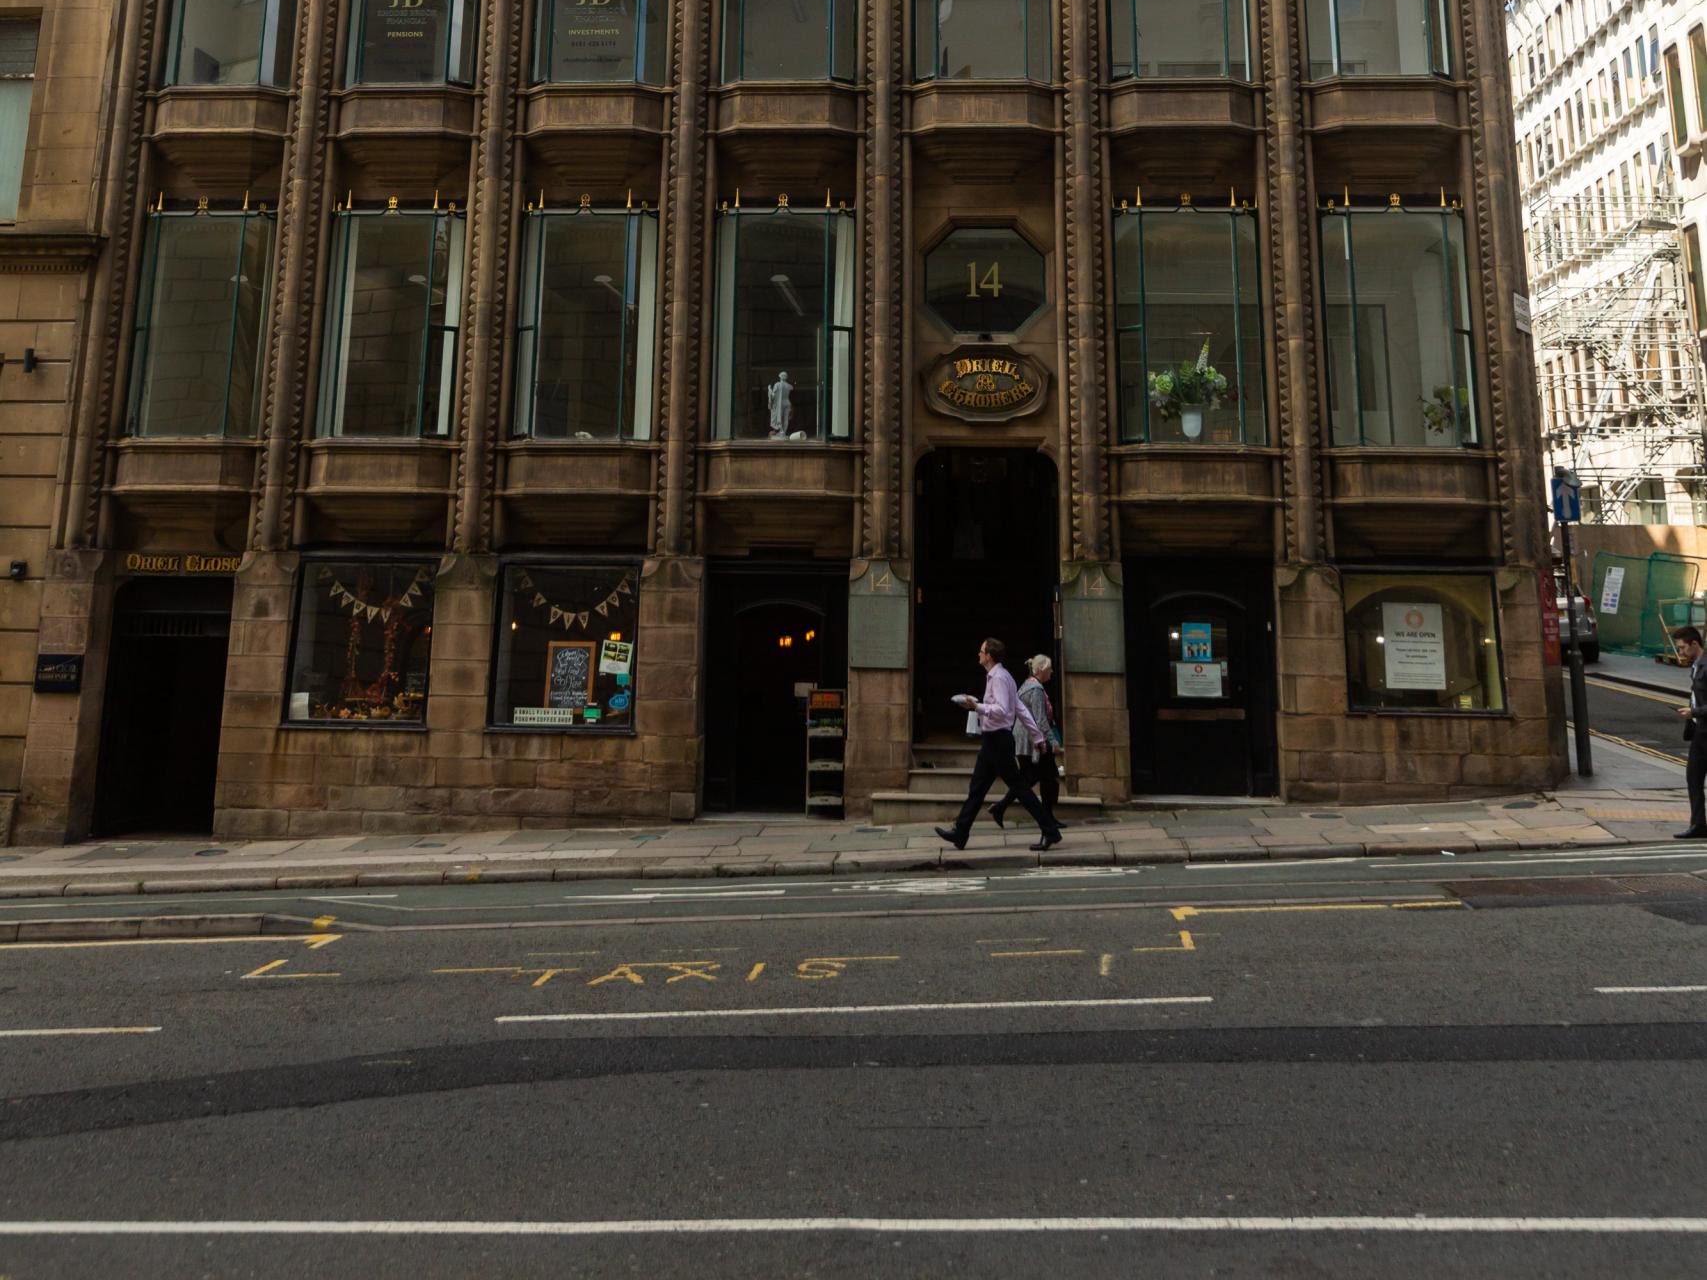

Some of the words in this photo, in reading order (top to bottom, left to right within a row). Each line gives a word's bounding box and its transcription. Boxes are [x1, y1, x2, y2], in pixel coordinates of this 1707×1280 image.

[568, 28, 620, 36] INVESTMENTS
[966, 261, 1003, 298] 14
[953, 358, 1020, 380] ORIEL
[127, 553, 180, 571] ORIEL
[185, 553, 241, 572] CLOSE
[870, 571, 892, 592] 14
[1083, 575, 1105, 597] 14
[1419, 631, 1436, 639] OPEN
[518, 960, 847, 987] TAXIS
